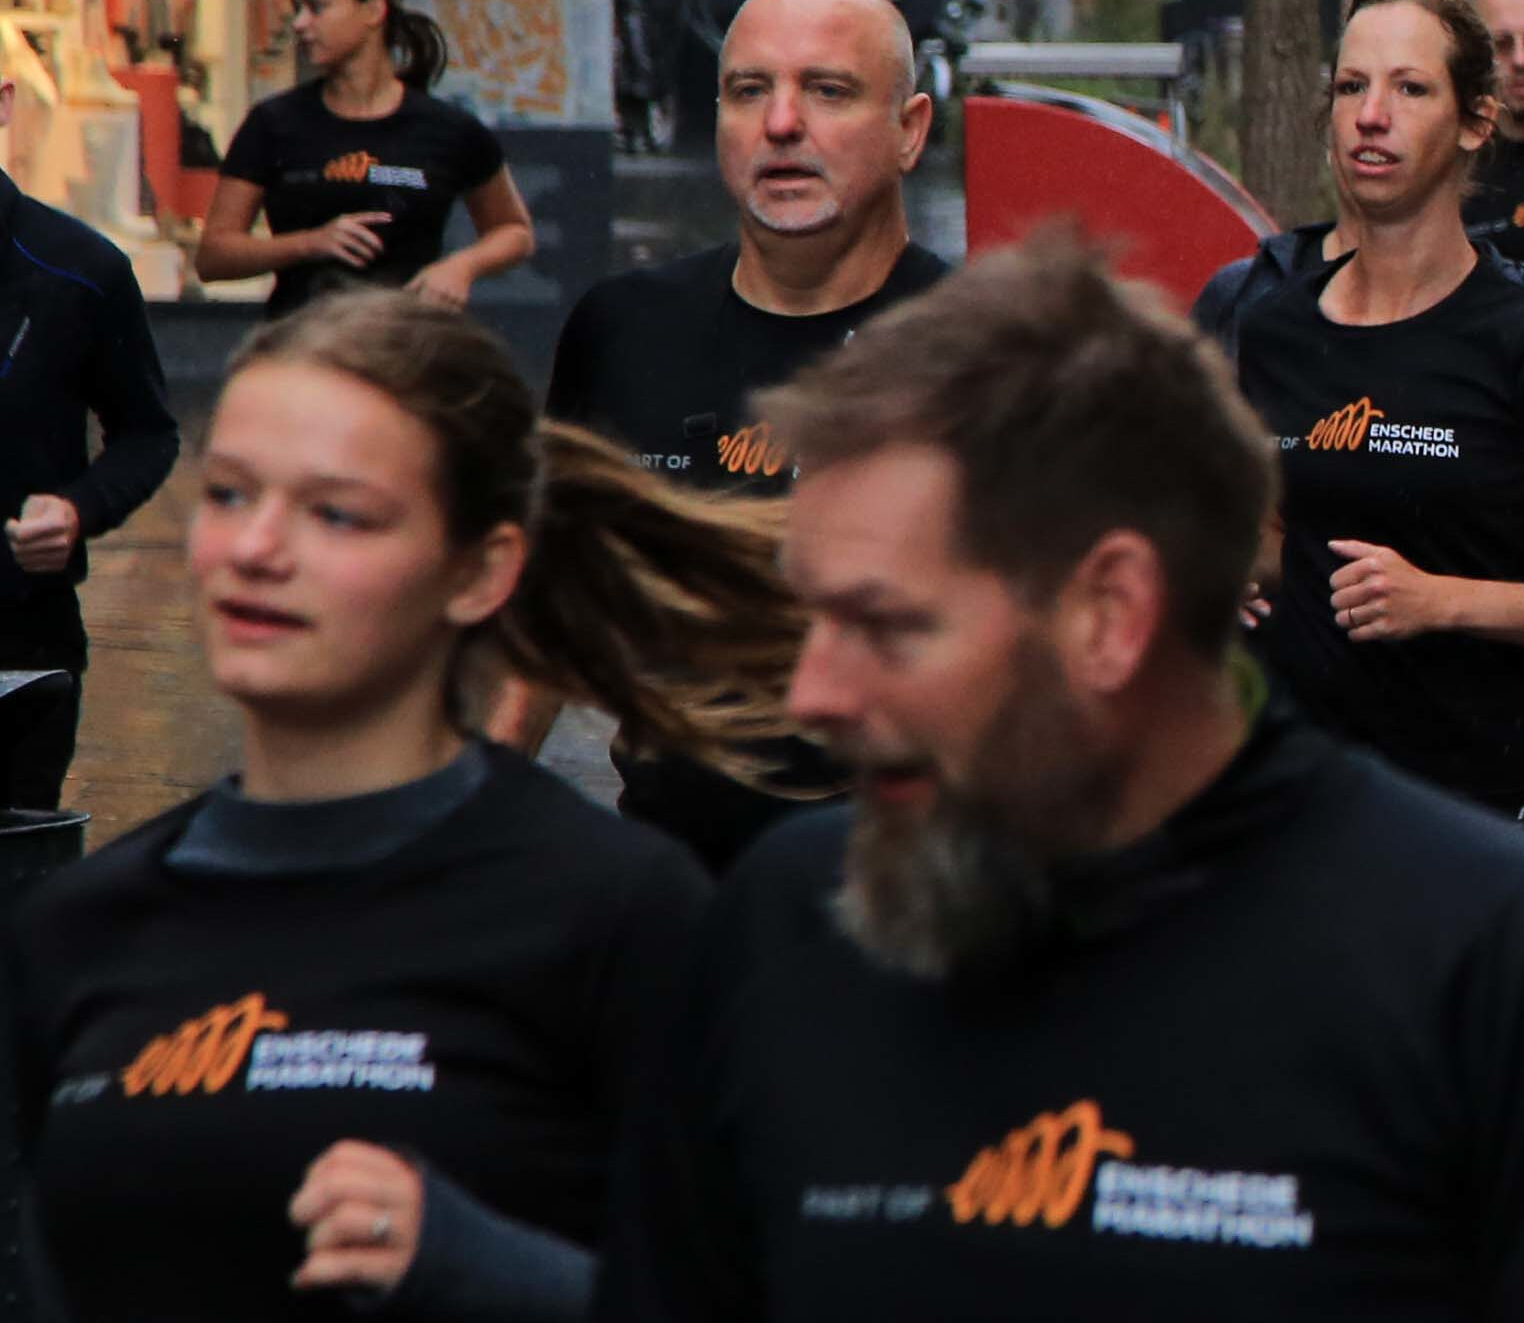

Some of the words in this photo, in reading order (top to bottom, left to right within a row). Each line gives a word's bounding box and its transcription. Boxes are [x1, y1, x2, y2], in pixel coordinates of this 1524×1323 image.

[1370, 423, 1454, 443] ENSCHEDE
[1282, 437, 1300, 449] OF
[1368, 439, 1459, 458] MARATHON
[666, 455, 691, 469] OF
